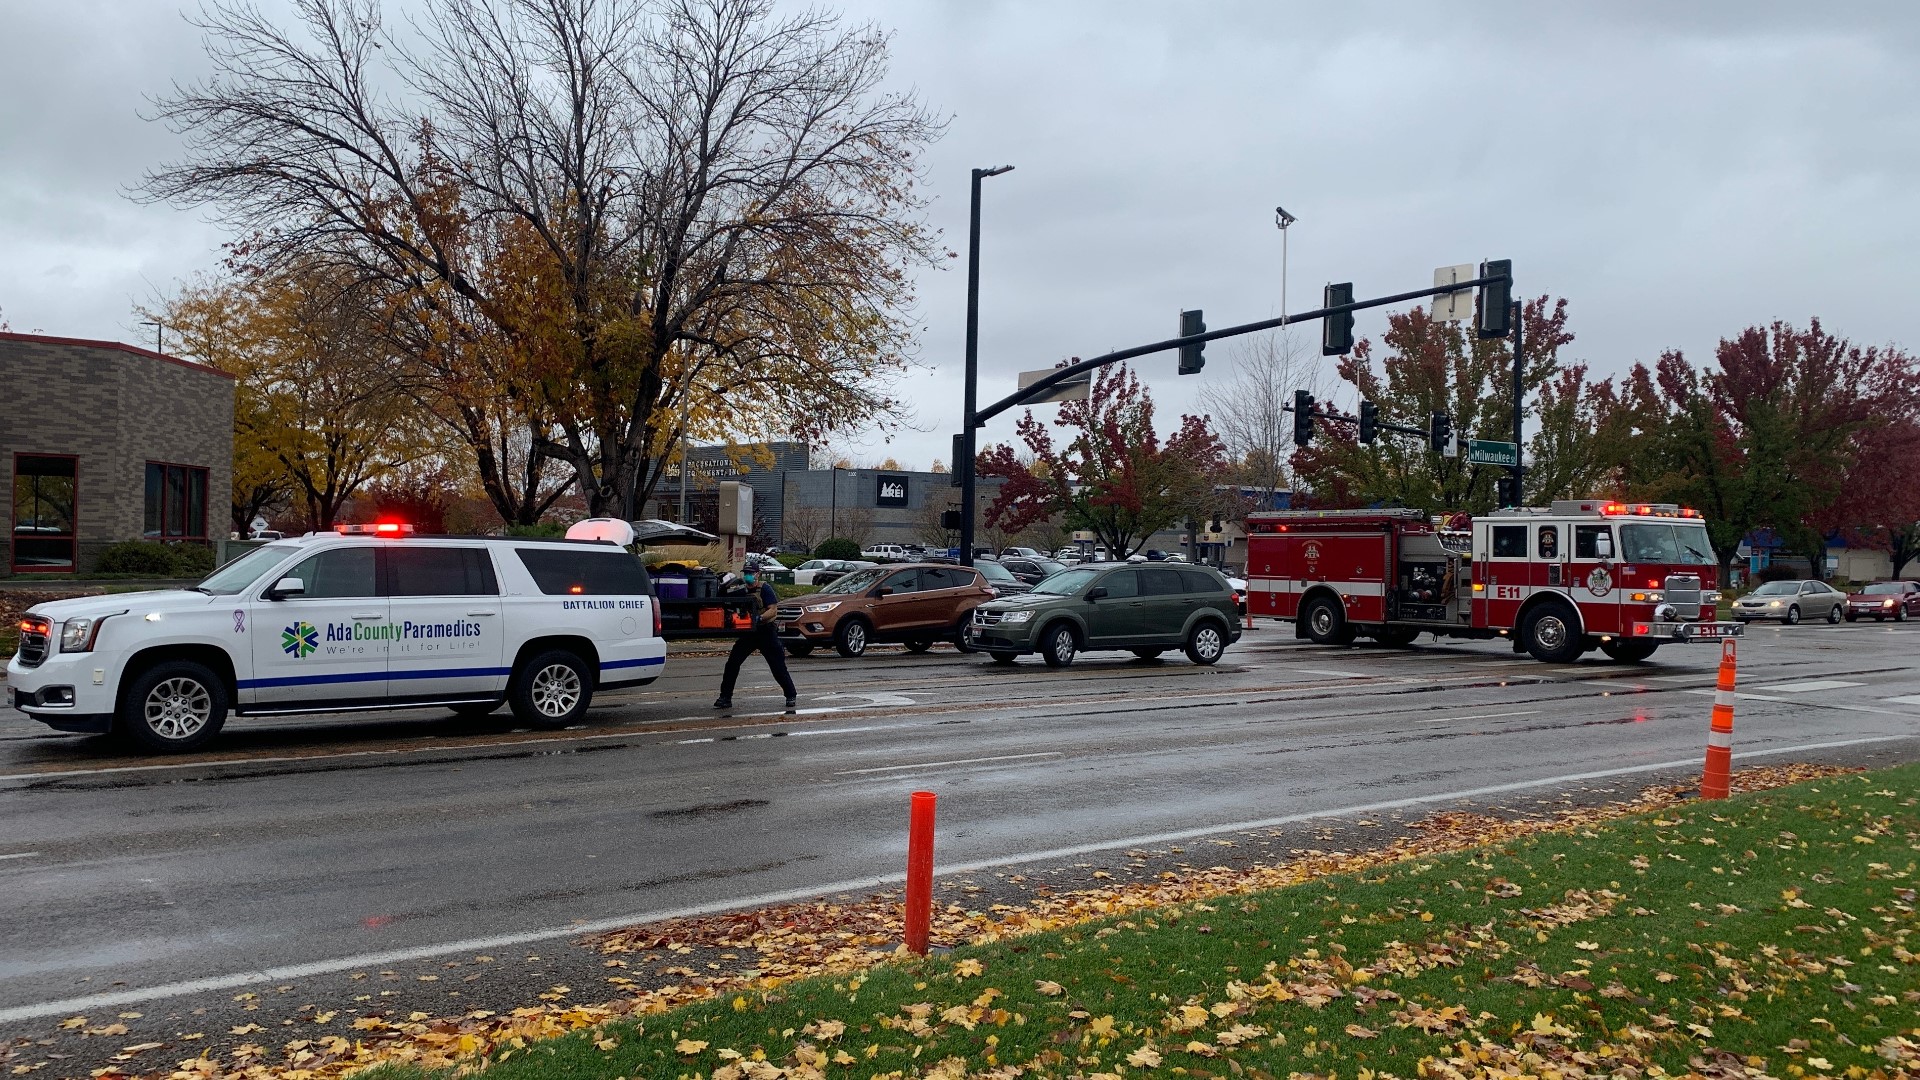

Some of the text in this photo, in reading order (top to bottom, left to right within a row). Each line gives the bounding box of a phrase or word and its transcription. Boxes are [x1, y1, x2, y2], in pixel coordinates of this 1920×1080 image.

[1475, 450, 1510, 463] Milwaukee
[687, 459, 735, 469] RECREATIONA
[1497, 586, 1520, 599] E11
[563, 600, 645, 610] BATTALION CHIEF
[326, 645, 365, 655] We're
[401, 643, 410, 652] it
[420, 641, 441, 651] for
